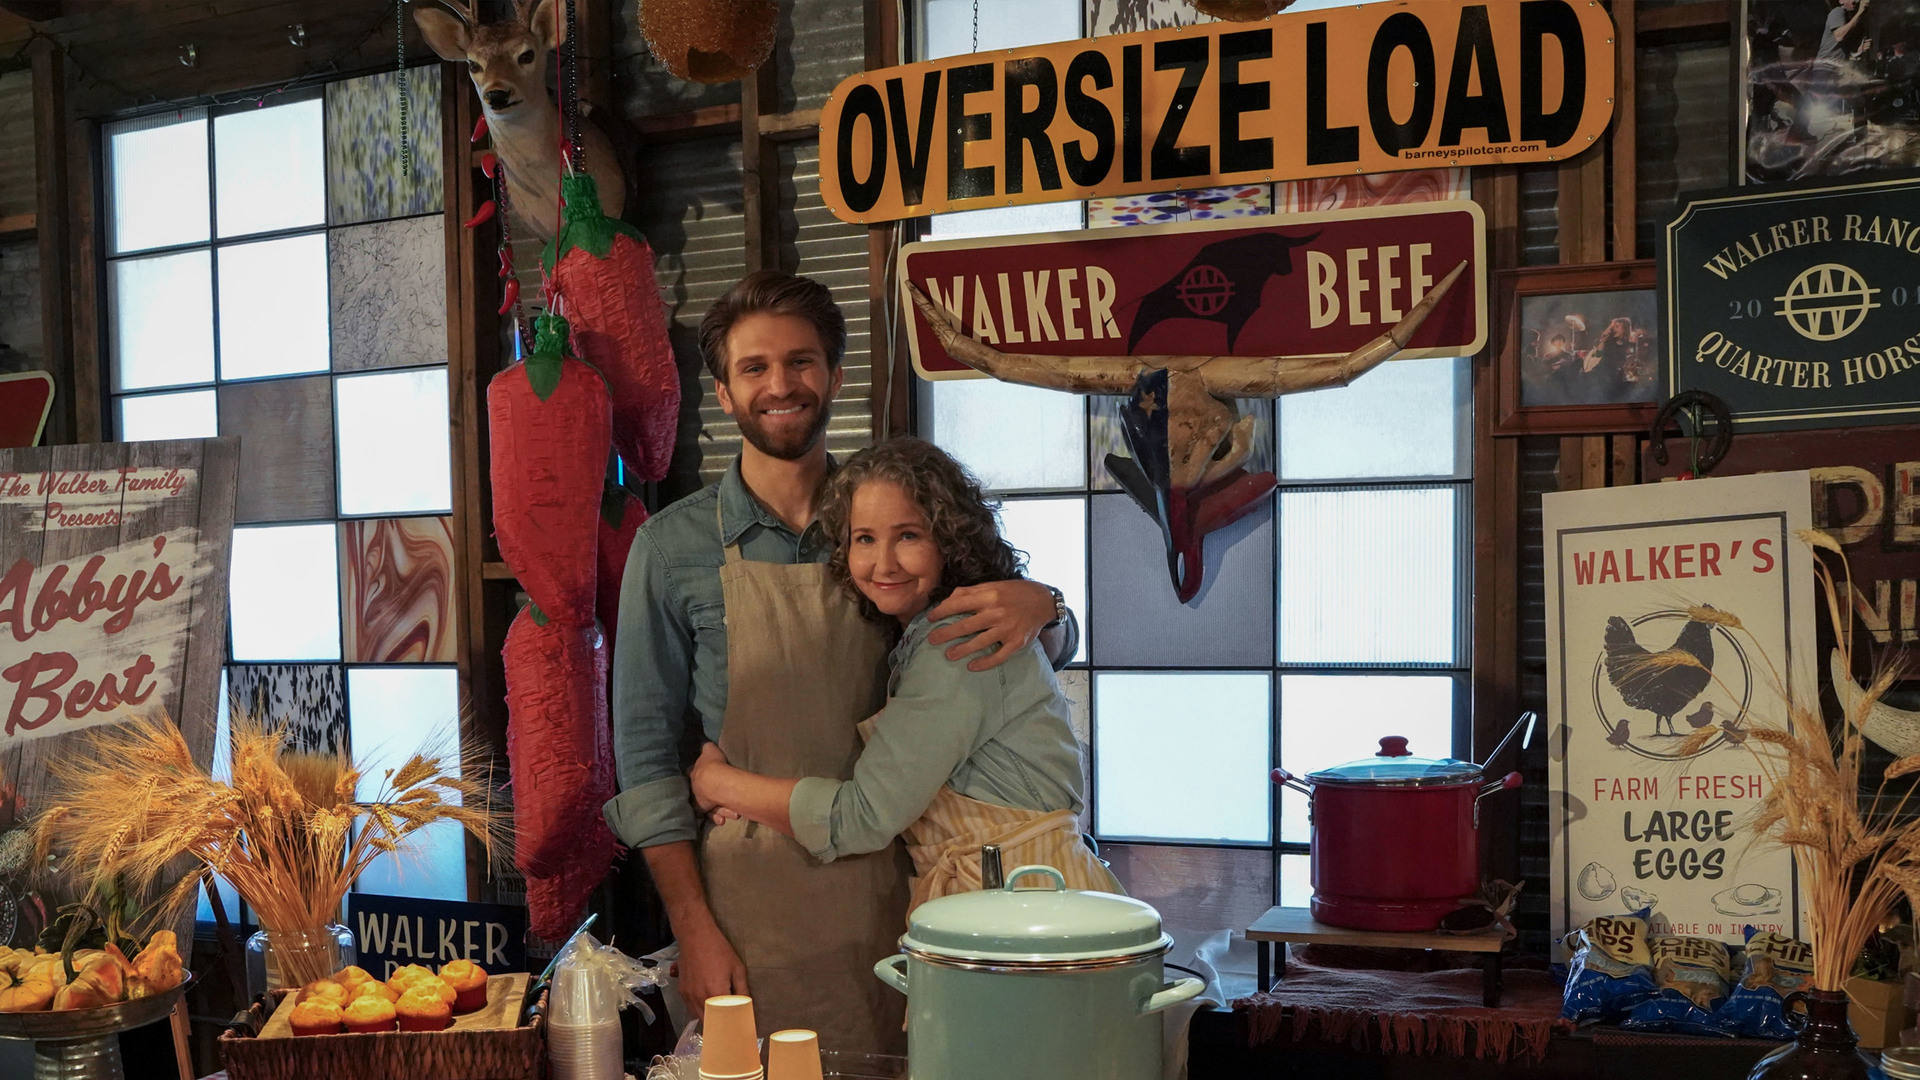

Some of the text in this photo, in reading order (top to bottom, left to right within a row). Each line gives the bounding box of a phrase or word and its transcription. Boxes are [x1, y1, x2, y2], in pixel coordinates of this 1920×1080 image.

[837, 0, 1586, 212] OVERSIZE LOAD
[1405, 144, 1539, 159] barneyspilotcar.com
[1703, 214, 1920, 280] WALKER RANC
[925, 243, 1433, 344] WALKER BEEF
[1729, 299, 1762, 319] 20
[1695, 331, 1920, 389] QUARTER HORS
[0, 466, 186, 497] The Walker Family
[1573, 538, 1774, 586] WALKER'S
[0, 535, 184, 642] Abby's
[2, 651, 157, 737] Best
[1594, 775, 1762, 801] FARM FRESH
[1624, 810, 1735, 843] LARGE
[1633, 848, 1726, 881] EGGS
[358, 911, 510, 967] WALKER
[1648, 923, 1783, 935] AILABLE ON INIRY
[1652, 936, 1727, 957] ORN
